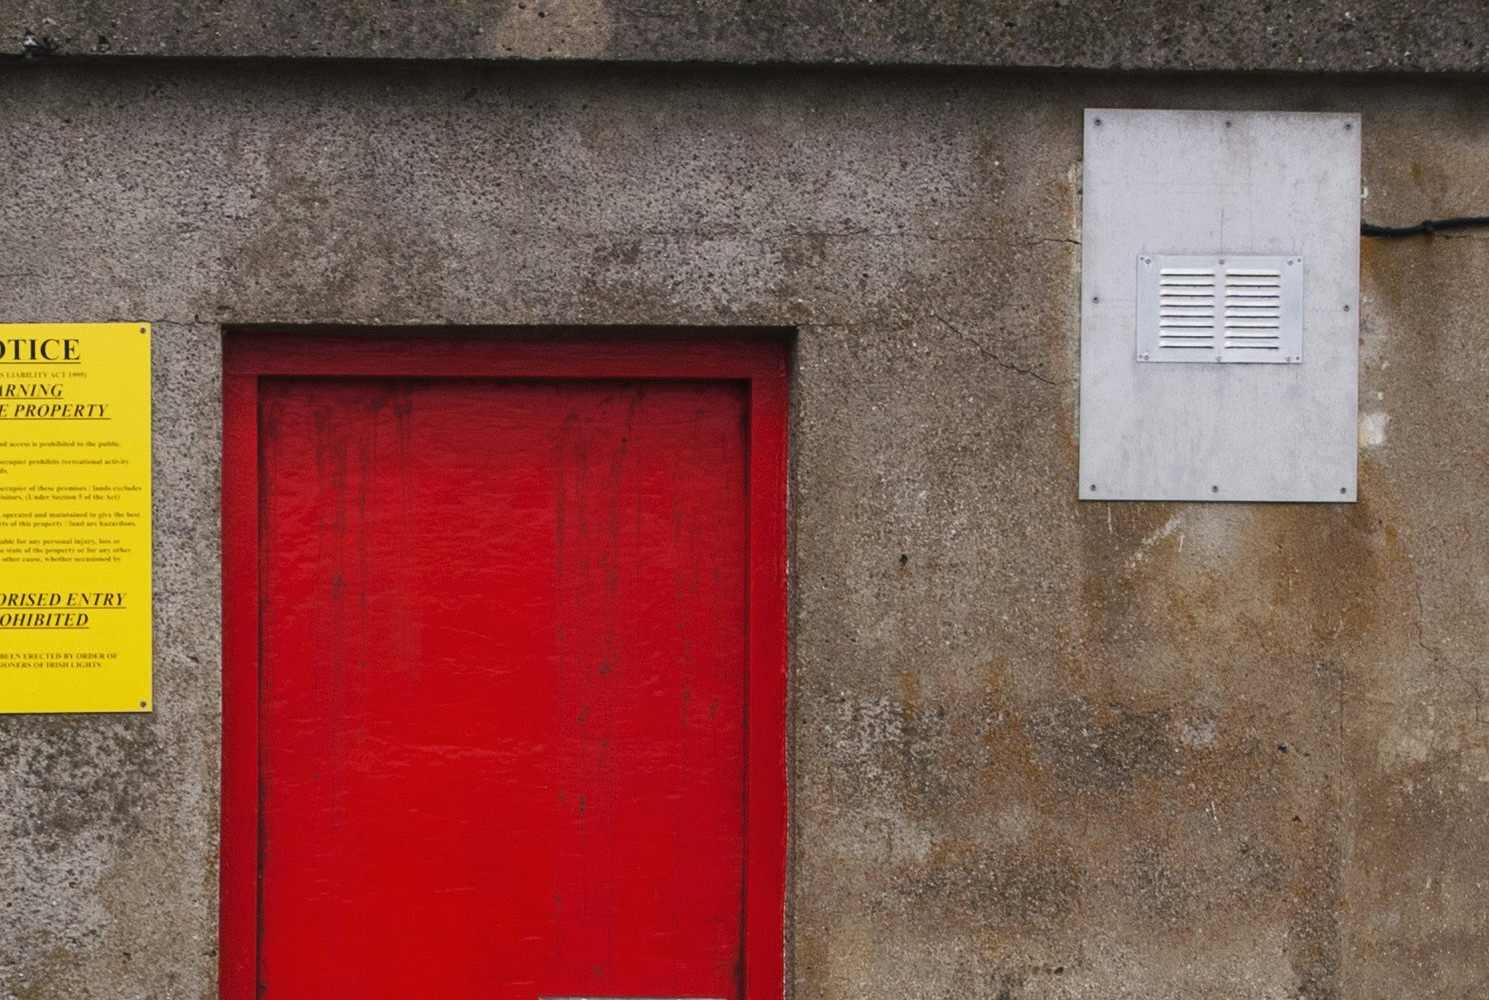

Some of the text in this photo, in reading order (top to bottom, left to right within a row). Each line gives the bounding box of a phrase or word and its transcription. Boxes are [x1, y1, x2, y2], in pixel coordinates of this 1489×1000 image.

[6, 371, 47, 379] LIABILITY
[51, 371, 65, 379] ACT
[13, 404, 109, 417] PROPERTY
[39, 441, 75, 449] prohibited
[85, 440, 96, 448] the
[28, 459, 60, 467] prohibits
[93, 484, 111, 492] lands
[112, 484, 142, 492] excludes
[93, 493, 103, 501] the
[2, 512, 33, 520] operated
[34, 511, 47, 519] and
[49, 511, 88, 519] maintained
[98, 512, 112, 520] give
[33, 521, 62, 529] property
[99, 519, 136, 527] hazardous.
[16, 537, 27, 545] for
[43, 538, 72, 546] personal
[99, 537, 111, 545] loss
[32, 546, 43, 554] the
[45, 547, 75, 555] property
[87, 546, 96, 554] for
[113, 546, 131, 554] other
[45, 555, 72, 563] whether
[74, 555, 111, 563] occasioned
[66, 593, 127, 606] ENTRY
[0, 652, 21, 660] BEEN
[23, 652, 62, 660] ERECTED
[63, 652, 73, 660] BY
[76, 652, 105, 660] ORDER
[107, 652, 118, 660] OF
[33, 661, 44, 669] OF
[46, 661, 69, 669] IRISH
[71, 661, 102, 669] LIGHTS
